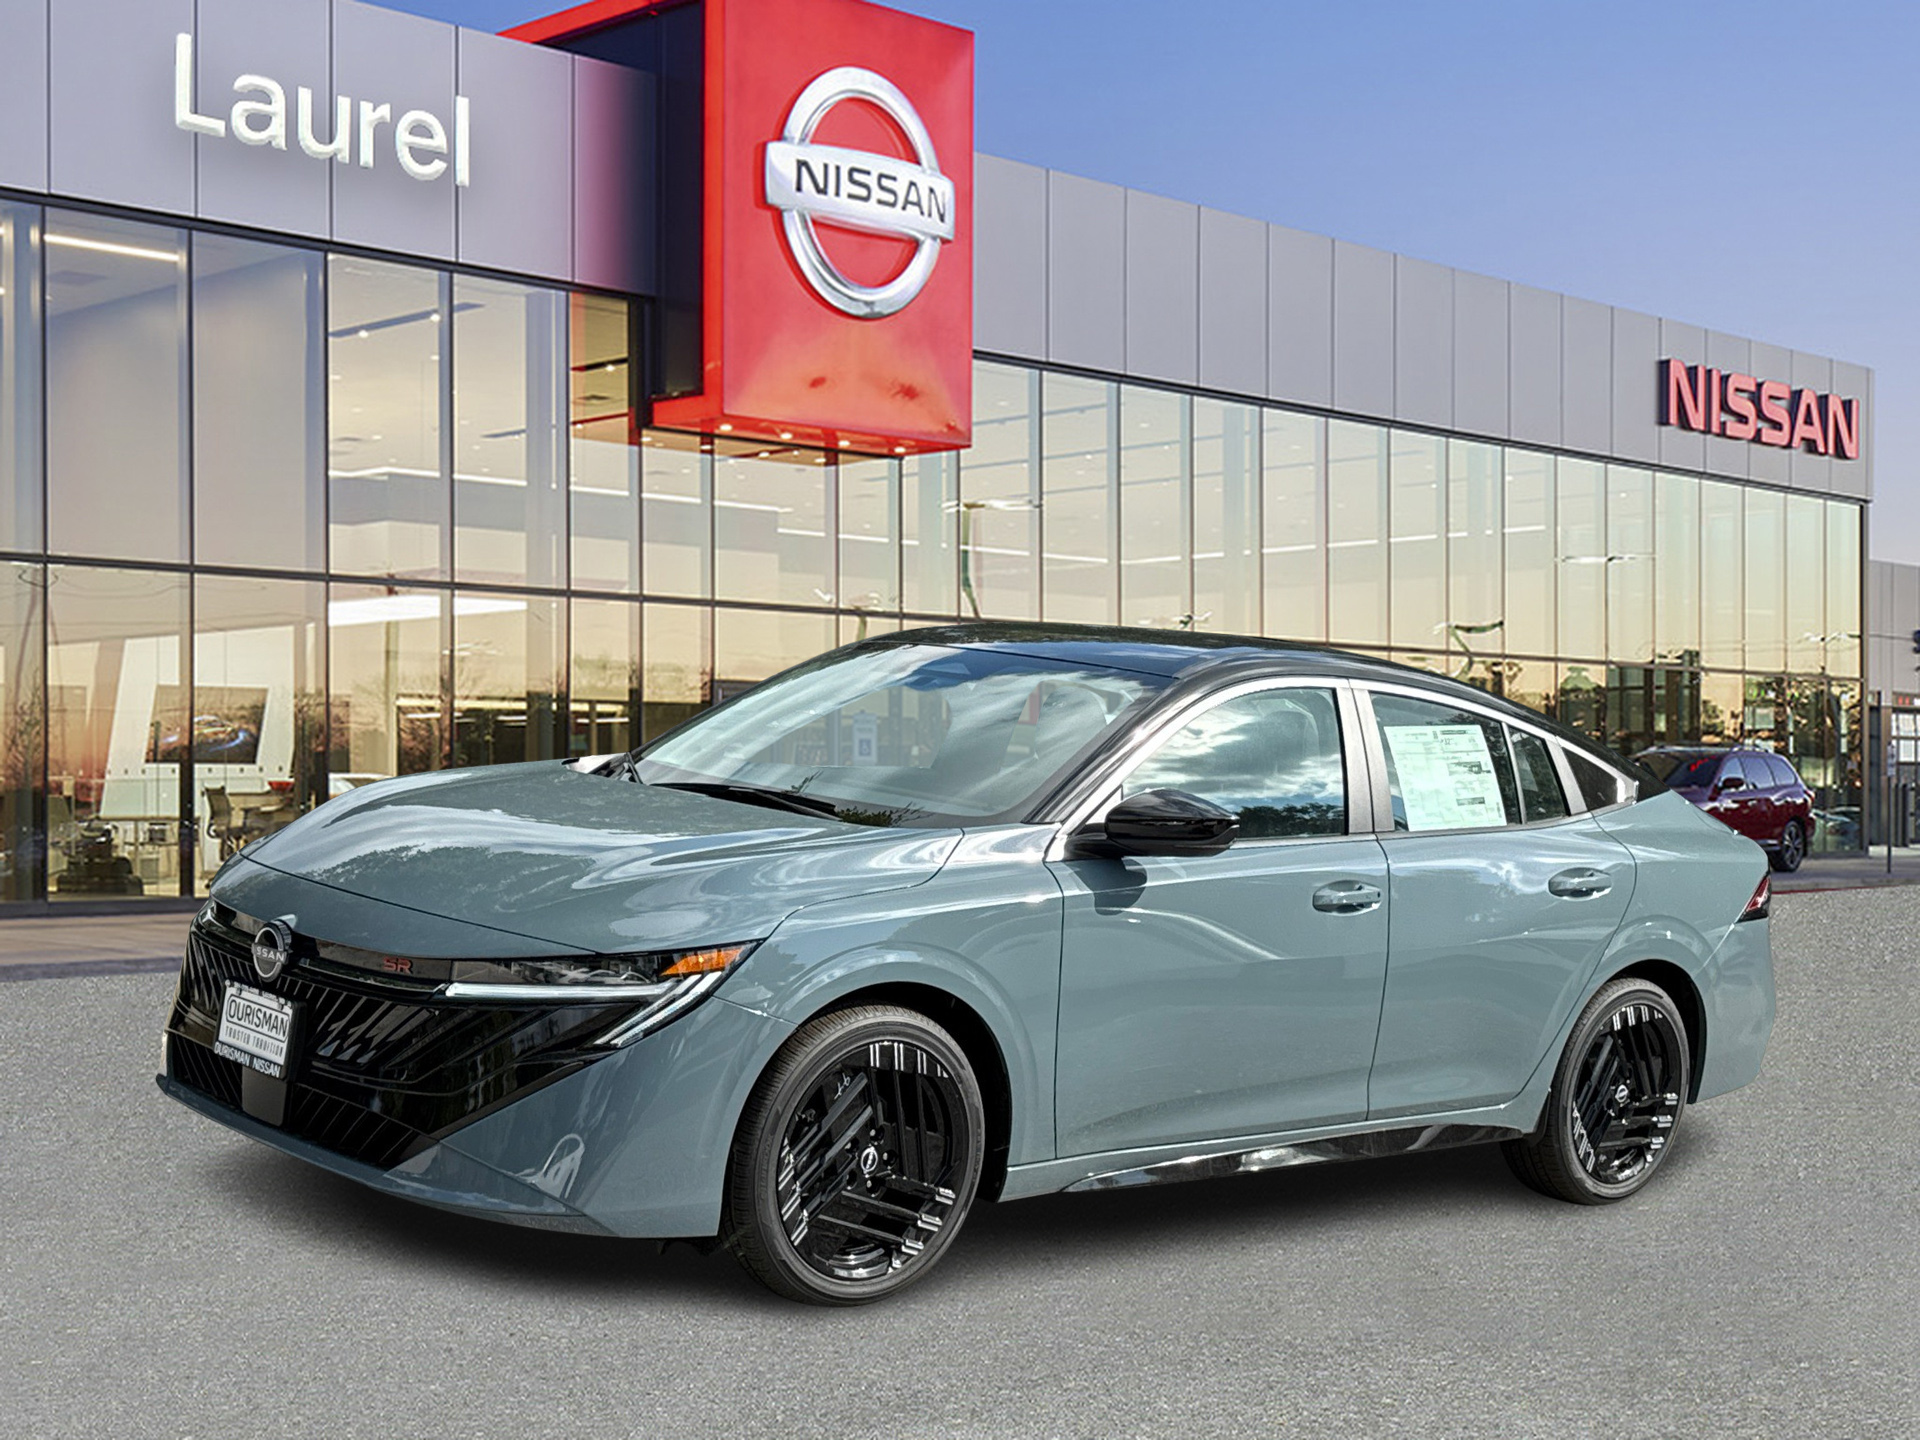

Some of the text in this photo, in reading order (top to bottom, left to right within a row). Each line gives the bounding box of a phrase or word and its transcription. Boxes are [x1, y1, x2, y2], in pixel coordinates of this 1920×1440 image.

[175, 33, 469, 187] Laurel
[795, 158, 946, 224] NISSAN
[1657, 358, 1859, 460] NISSAN
[256, 946, 285, 961] SSAN
[383, 955, 411, 974] SR
[228, 999, 288, 1038] OURISMAN
[214, 1041, 281, 1079] OURISMAN NISSAN
